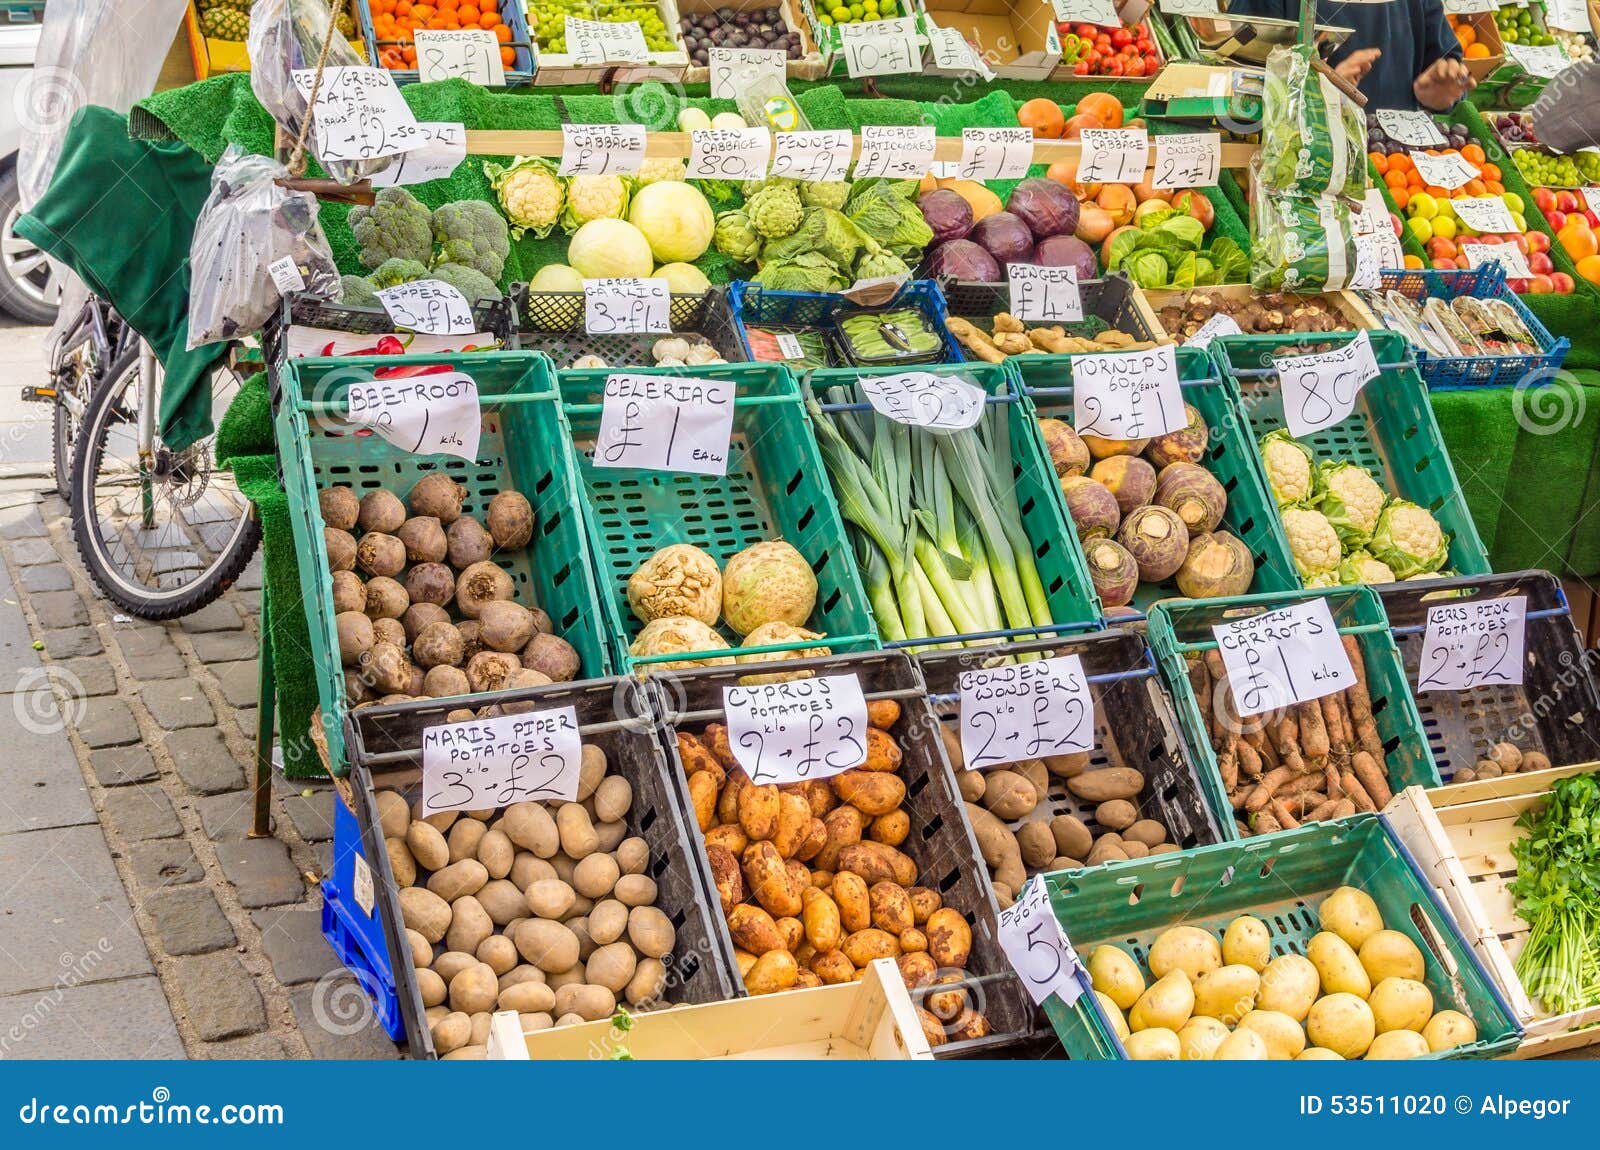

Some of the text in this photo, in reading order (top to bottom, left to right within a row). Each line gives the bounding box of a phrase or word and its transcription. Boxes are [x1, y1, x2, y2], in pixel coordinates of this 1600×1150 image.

[566, 17, 640, 32] SEEDLESS
[844, 21, 904, 37] LIMES
[415, 32, 493, 44] TANGERINES
[711, 50, 784, 68] RED PLUMS
[852, 44, 880, 72] 10
[565, 125, 621, 136] WHITE
[693, 130, 741, 143] GREEN
[777, 135, 848, 150] FENNEL
[866, 127, 916, 139] GLOBE
[963, 130, 1032, 143] RED CABBAGE
[1082, 130, 1130, 140] SPRING
[1158, 136, 1202, 145] SPANISH
[574, 136, 641, 151] CABBAGE
[702, 138, 760, 154] CABBAGE
[1091, 140, 1144, 151] CABBAGE
[1166, 144, 1214, 156] ONIONS
[599, 278, 642, 287] LARGE
[1009, 265, 1074, 285] GINGER
[585, 286, 663, 299] GARLIC
[1014, 282, 1063, 320] £4
[588, 302, 617, 333] 3
[1073, 351, 1168, 376] TURNIPS
[1276, 340, 1367, 363] CAULIFLOWER
[351, 380, 474, 411] BEETROOT
[605, 378, 728, 405] CELERIAC
[865, 379, 958, 395] LEEKS
[1300, 369, 1358, 425] 80
[1077, 392, 1168, 439] 2 £1
[604, 401, 681, 467] £1
[1230, 609, 1293, 634] SCOTTISH
[1430, 602, 1511, 626] KERRS PINK
[1222, 616, 1324, 650] CARROTS
[1438, 617, 1508, 637] POTATOES
[960, 661, 1050, 691] GOLDEN
[1243, 645, 1299, 709] £1
[1419, 646, 1451, 688] 2
[728, 678, 831, 708] CYPRUS
[975, 673, 1081, 701] WONDERS
[750, 698, 833, 719] POTATOES
[424, 714, 576, 750] MARIS PIPER
[969, 711, 1007, 768] 2
[1026, 696, 1091, 756] £2
[450, 737, 555, 764] POTATOES
[739, 731, 778, 782] 2
[796, 714, 864, 777] £3
[426, 772, 474, 809] 3
[497, 754, 566, 804] £2
[1026, 921, 1061, 984] 5
